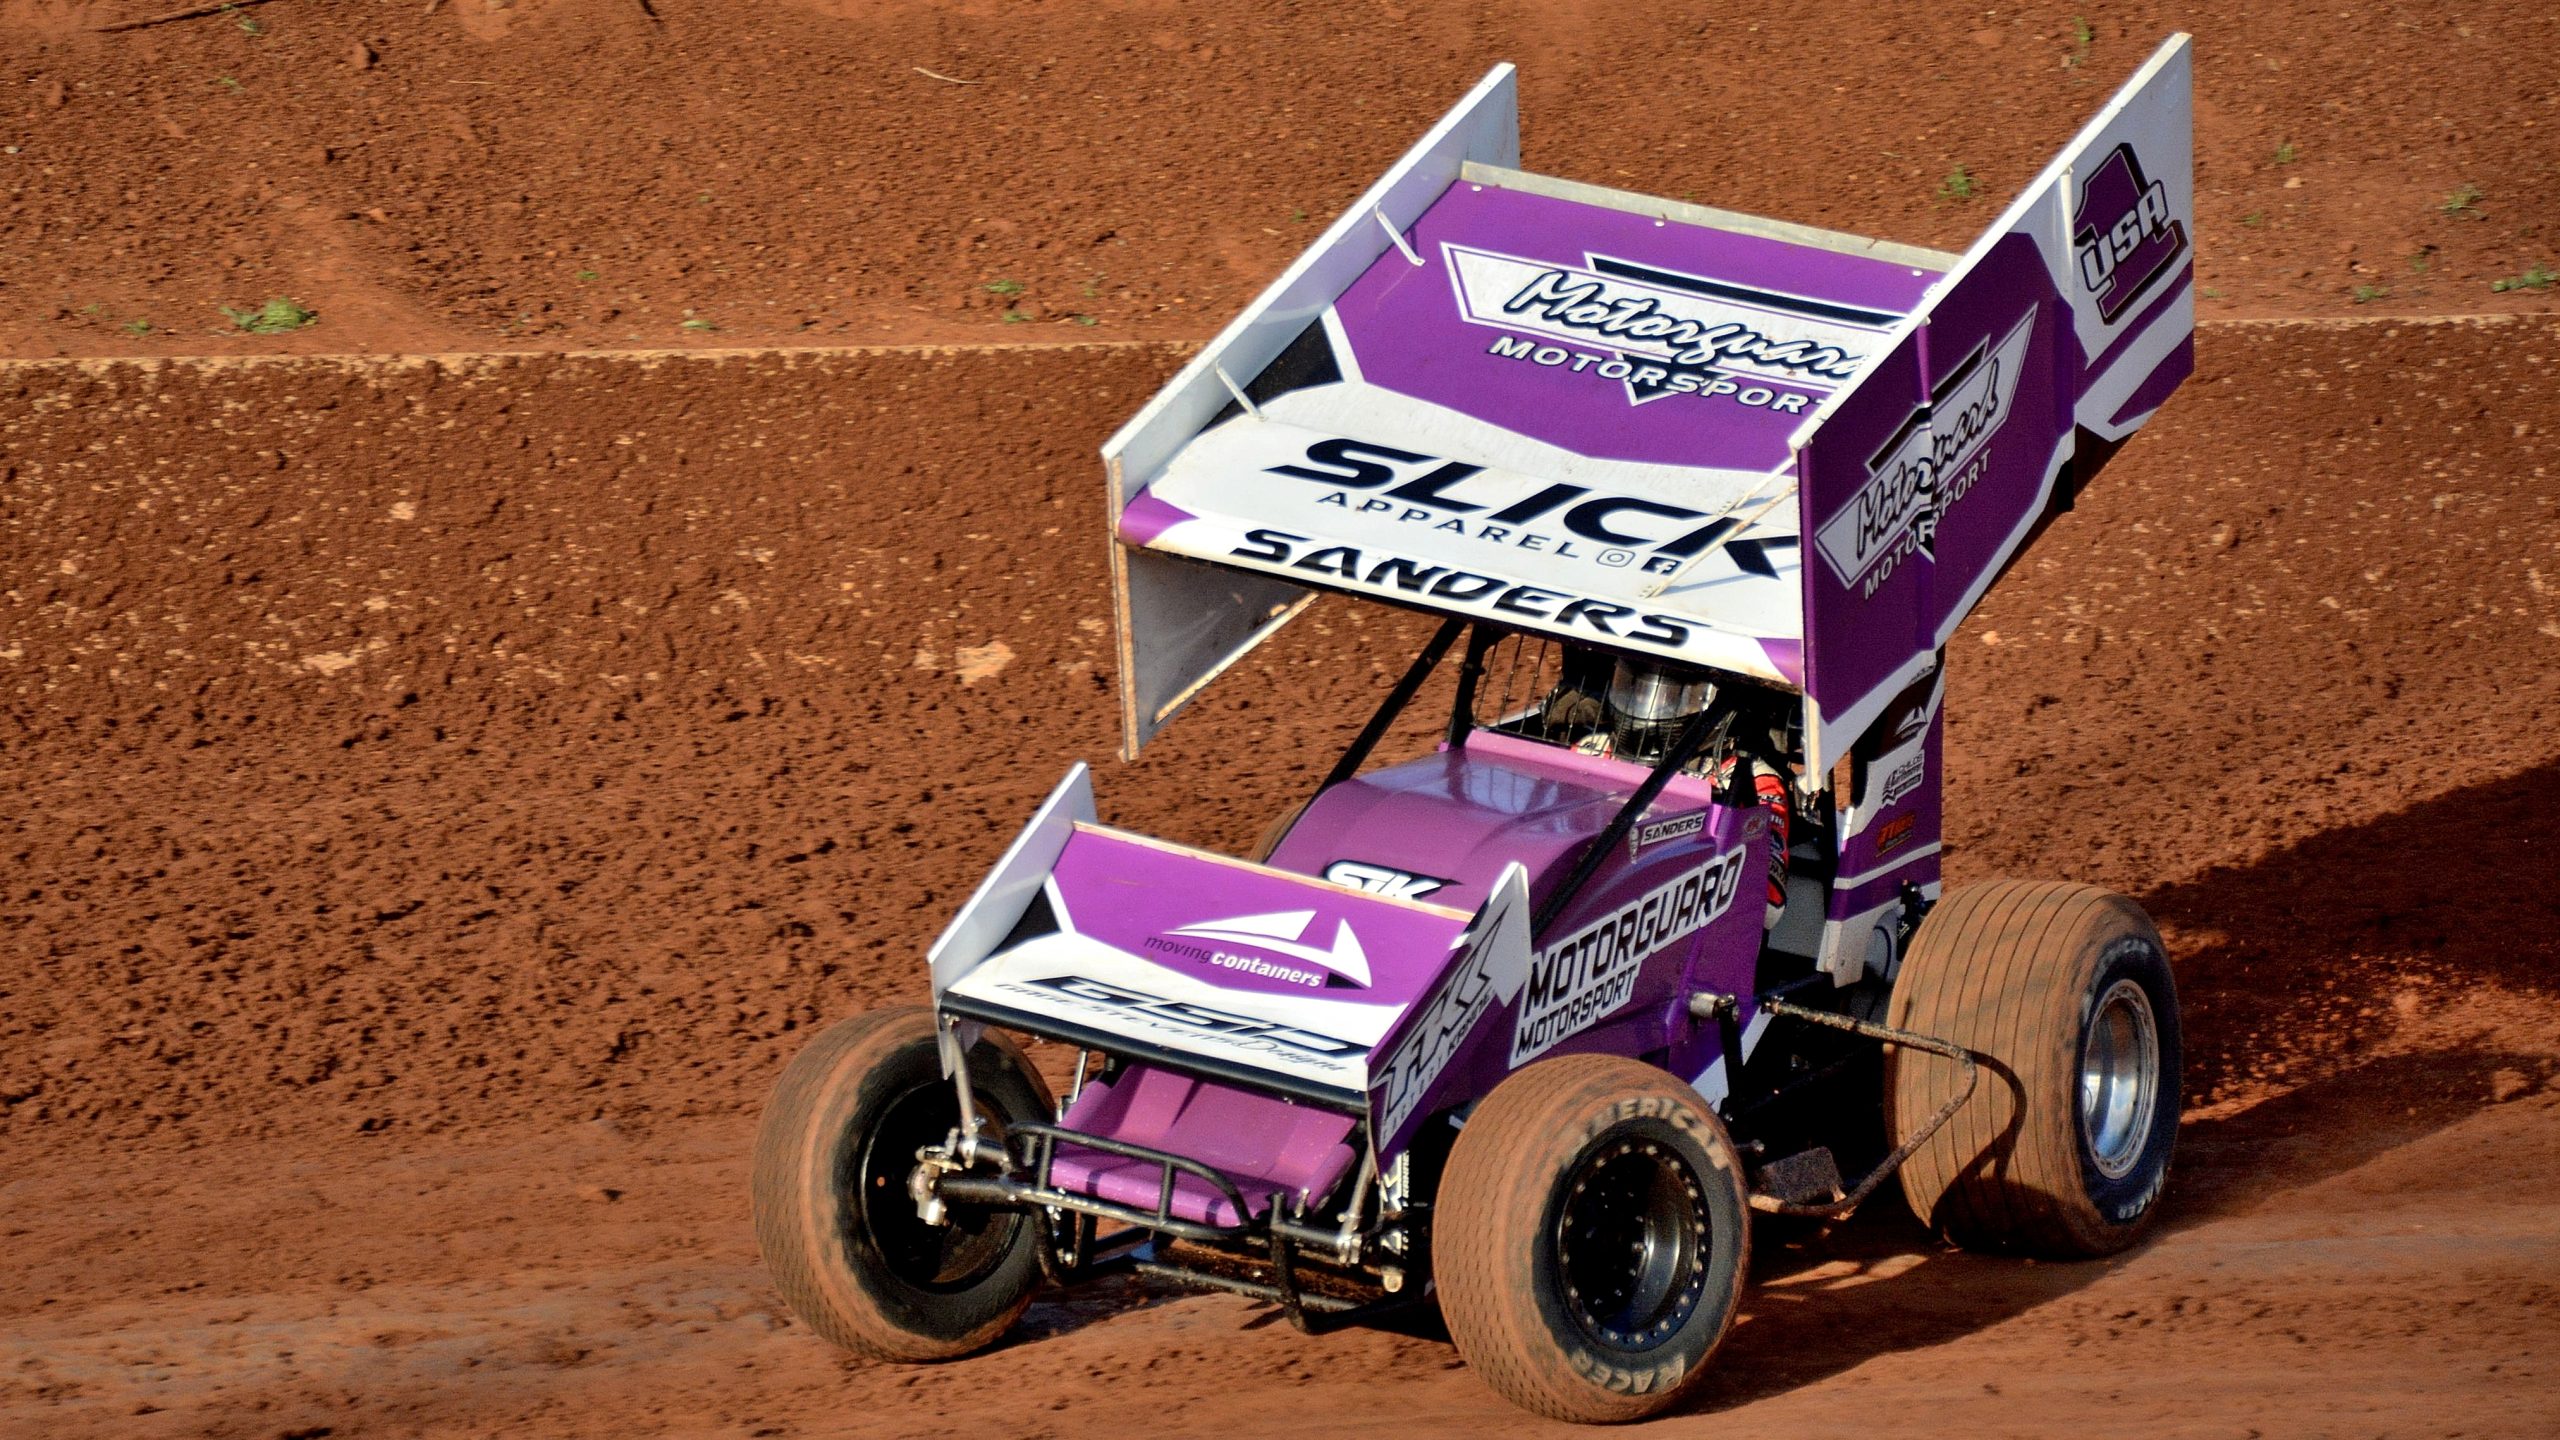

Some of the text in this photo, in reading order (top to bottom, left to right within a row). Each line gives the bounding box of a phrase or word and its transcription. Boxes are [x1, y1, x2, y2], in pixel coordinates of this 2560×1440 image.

[2081, 179, 2170, 292] USA
[1487, 335, 1828, 415] MOTORSPOR
[1261, 438, 1798, 580] SLICK
[1857, 356, 2000, 561] Motoruard
[1317, 491, 1580, 560] APPAREL
[1229, 528, 1711, 648] SANDERS
[1643, 815, 1704, 841] SANDERS
[1523, 852, 1743, 1018] MOTORGUARD
[1515, 965, 1637, 1058] MOTORSPORT
[1571, 1348, 1684, 1393] RACER
